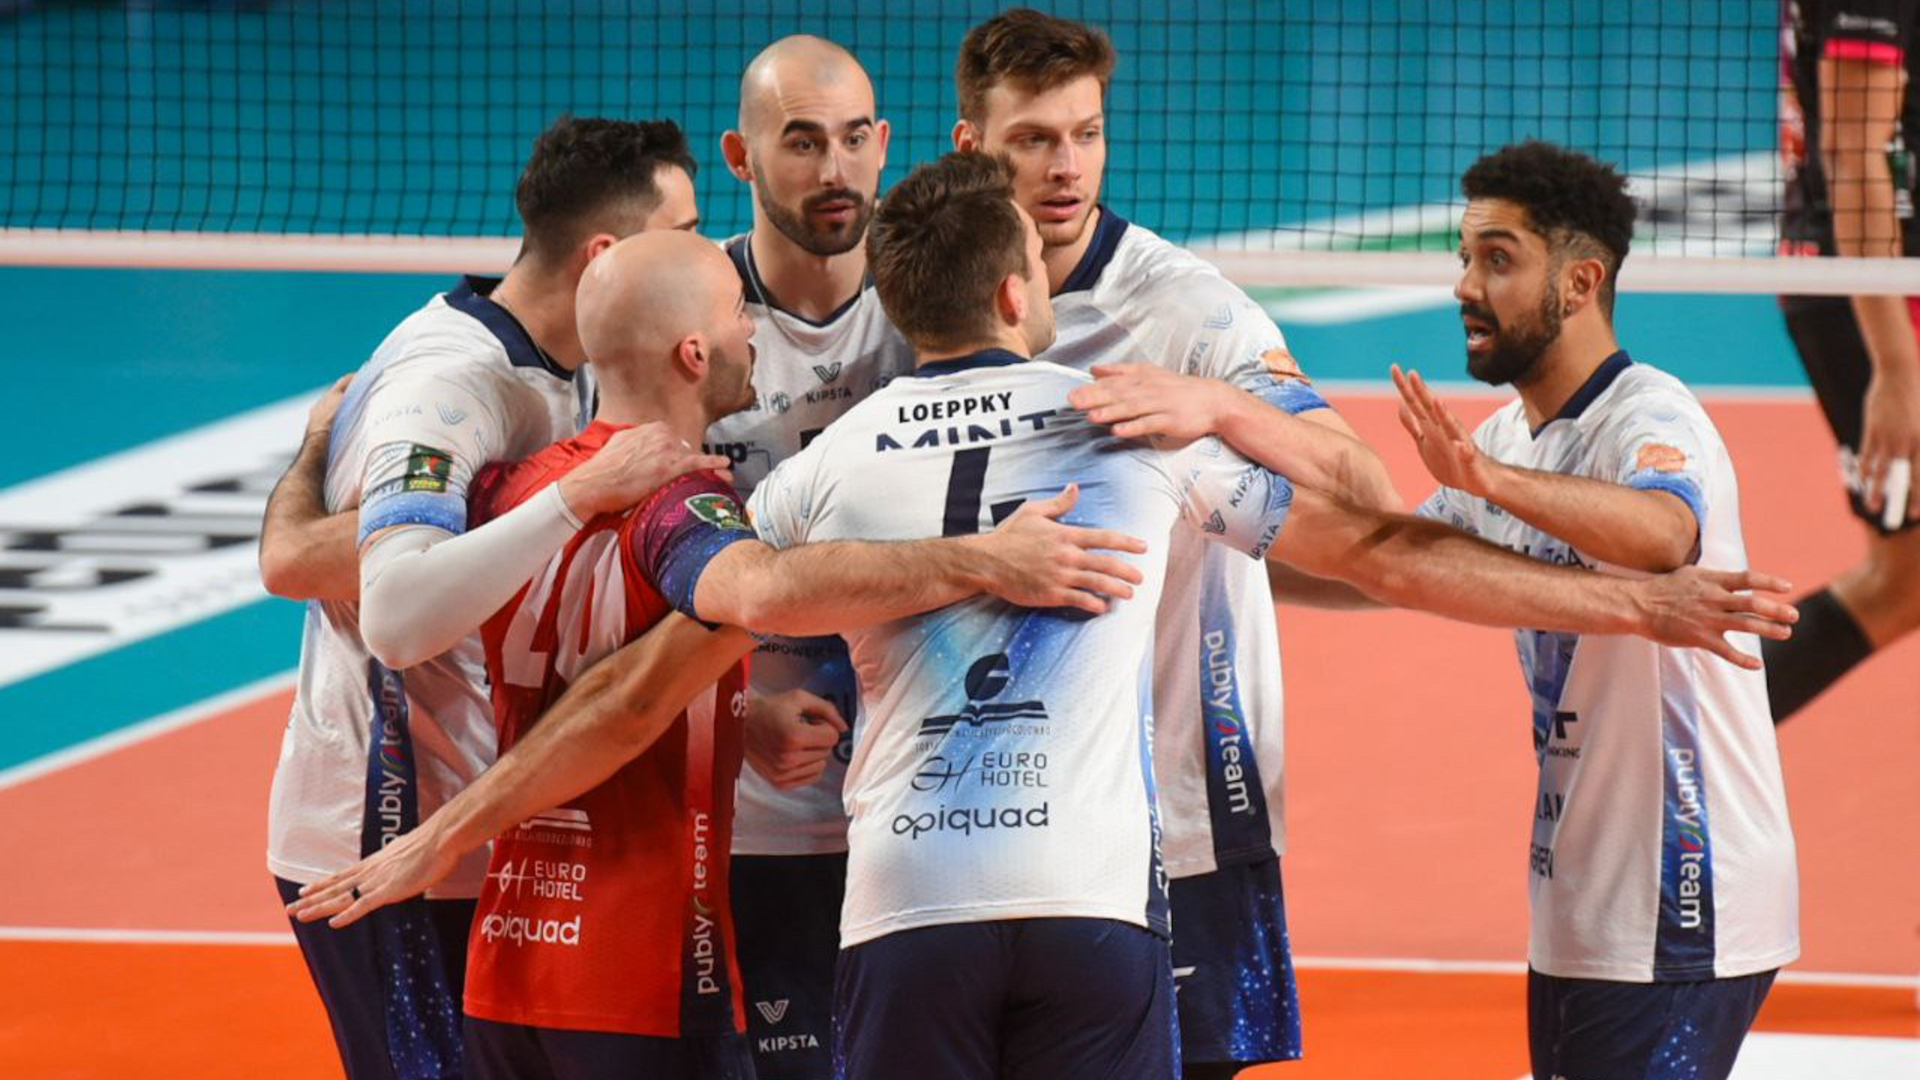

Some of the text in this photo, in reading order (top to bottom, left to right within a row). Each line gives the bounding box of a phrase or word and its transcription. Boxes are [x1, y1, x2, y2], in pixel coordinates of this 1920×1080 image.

[806, 388, 853, 405] KIPSTA
[898, 391, 1013, 424] LOEPPKY
[982, 752, 1048, 769] EURO
[980, 770, 1049, 787] HOTEL
[891, 802, 1049, 840] opiquad
[534, 860, 586, 882] EURO
[533, 880, 583, 901] HOTEL
[758, 1034, 820, 1053] KIPSTA
